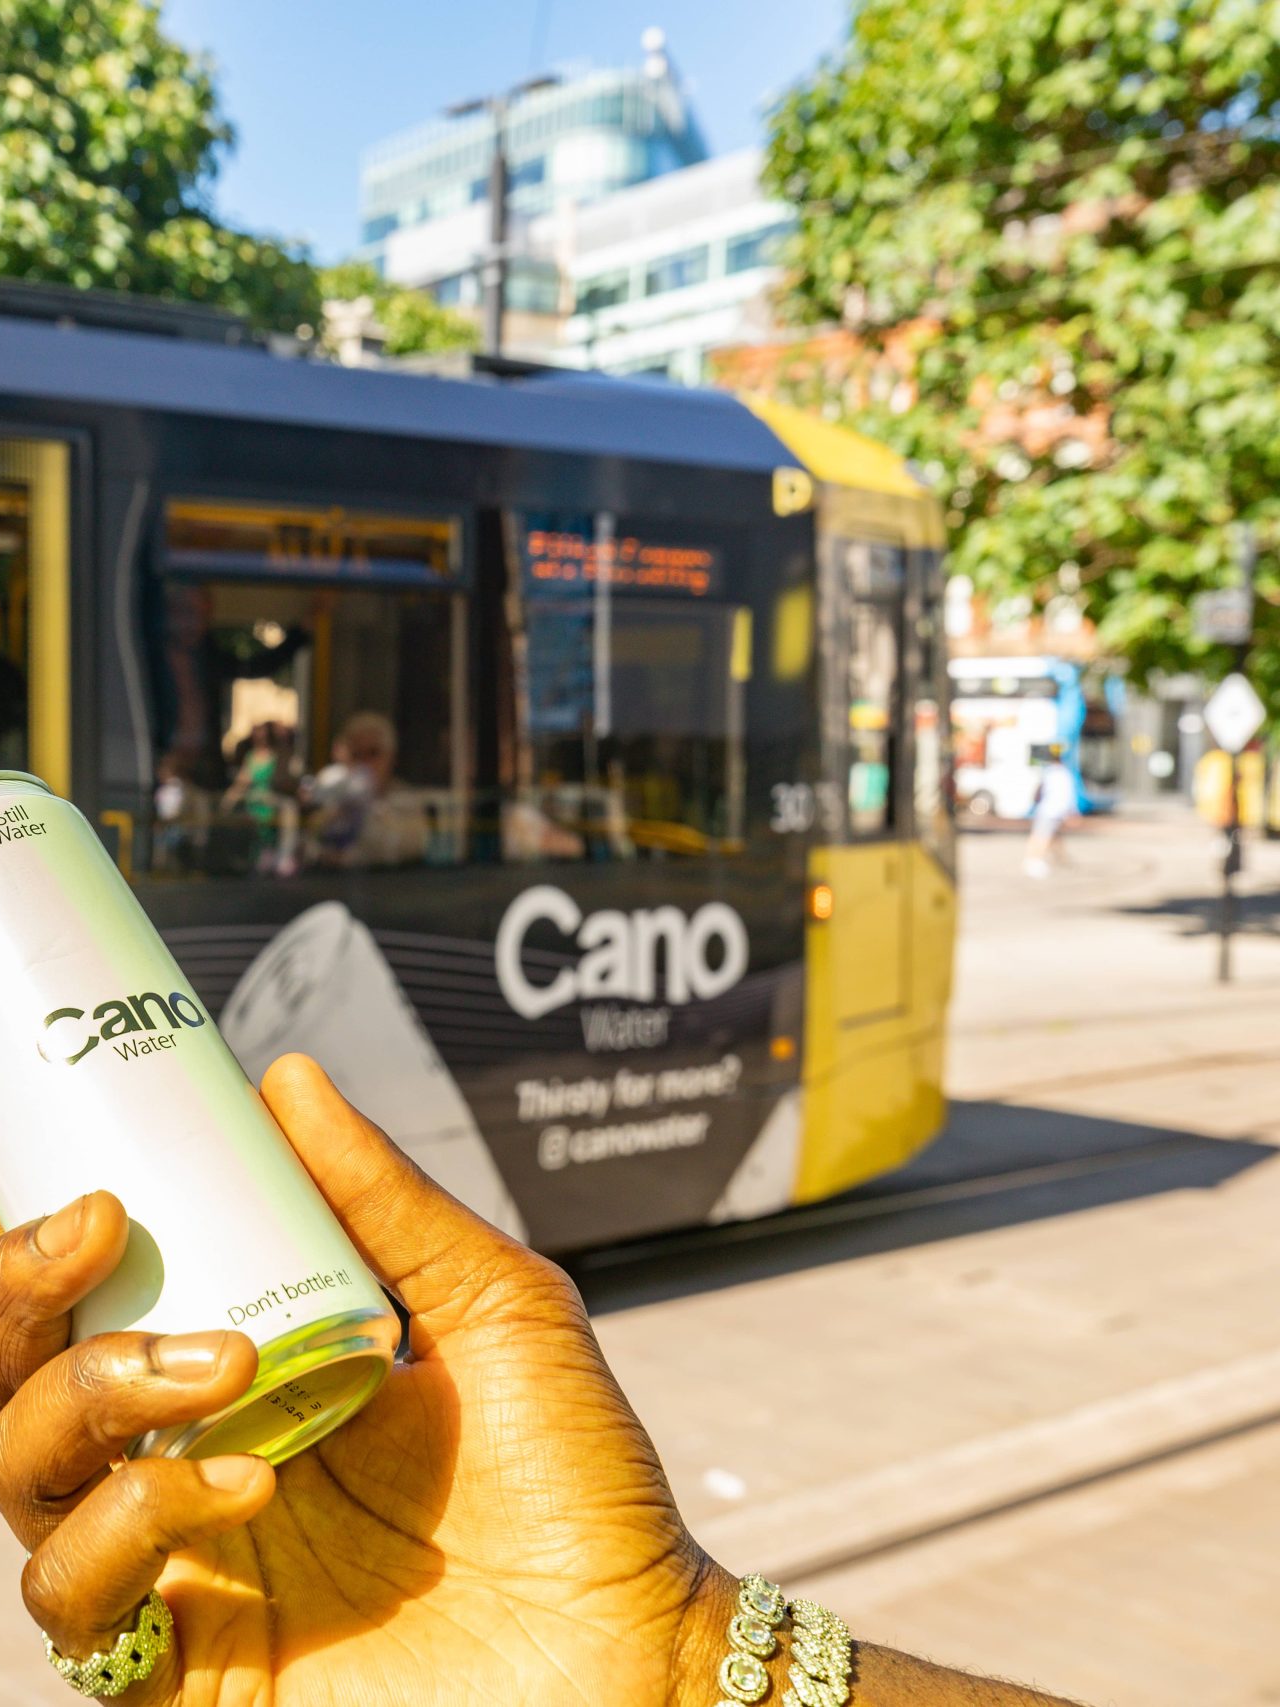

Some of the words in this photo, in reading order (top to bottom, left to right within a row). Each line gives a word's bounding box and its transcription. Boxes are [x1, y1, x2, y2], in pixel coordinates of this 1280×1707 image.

[495, 884, 749, 1021] Cano
[36, 991, 206, 1066] Cano
[113, 1032, 178, 1062] Water
[516, 1076, 612, 1123] Thirsty
[612, 1068, 655, 1109] for
[227, 1289, 283, 1326] Don't
[281, 1272, 336, 1300] bottle
[332, 1268, 353, 1286] it!
